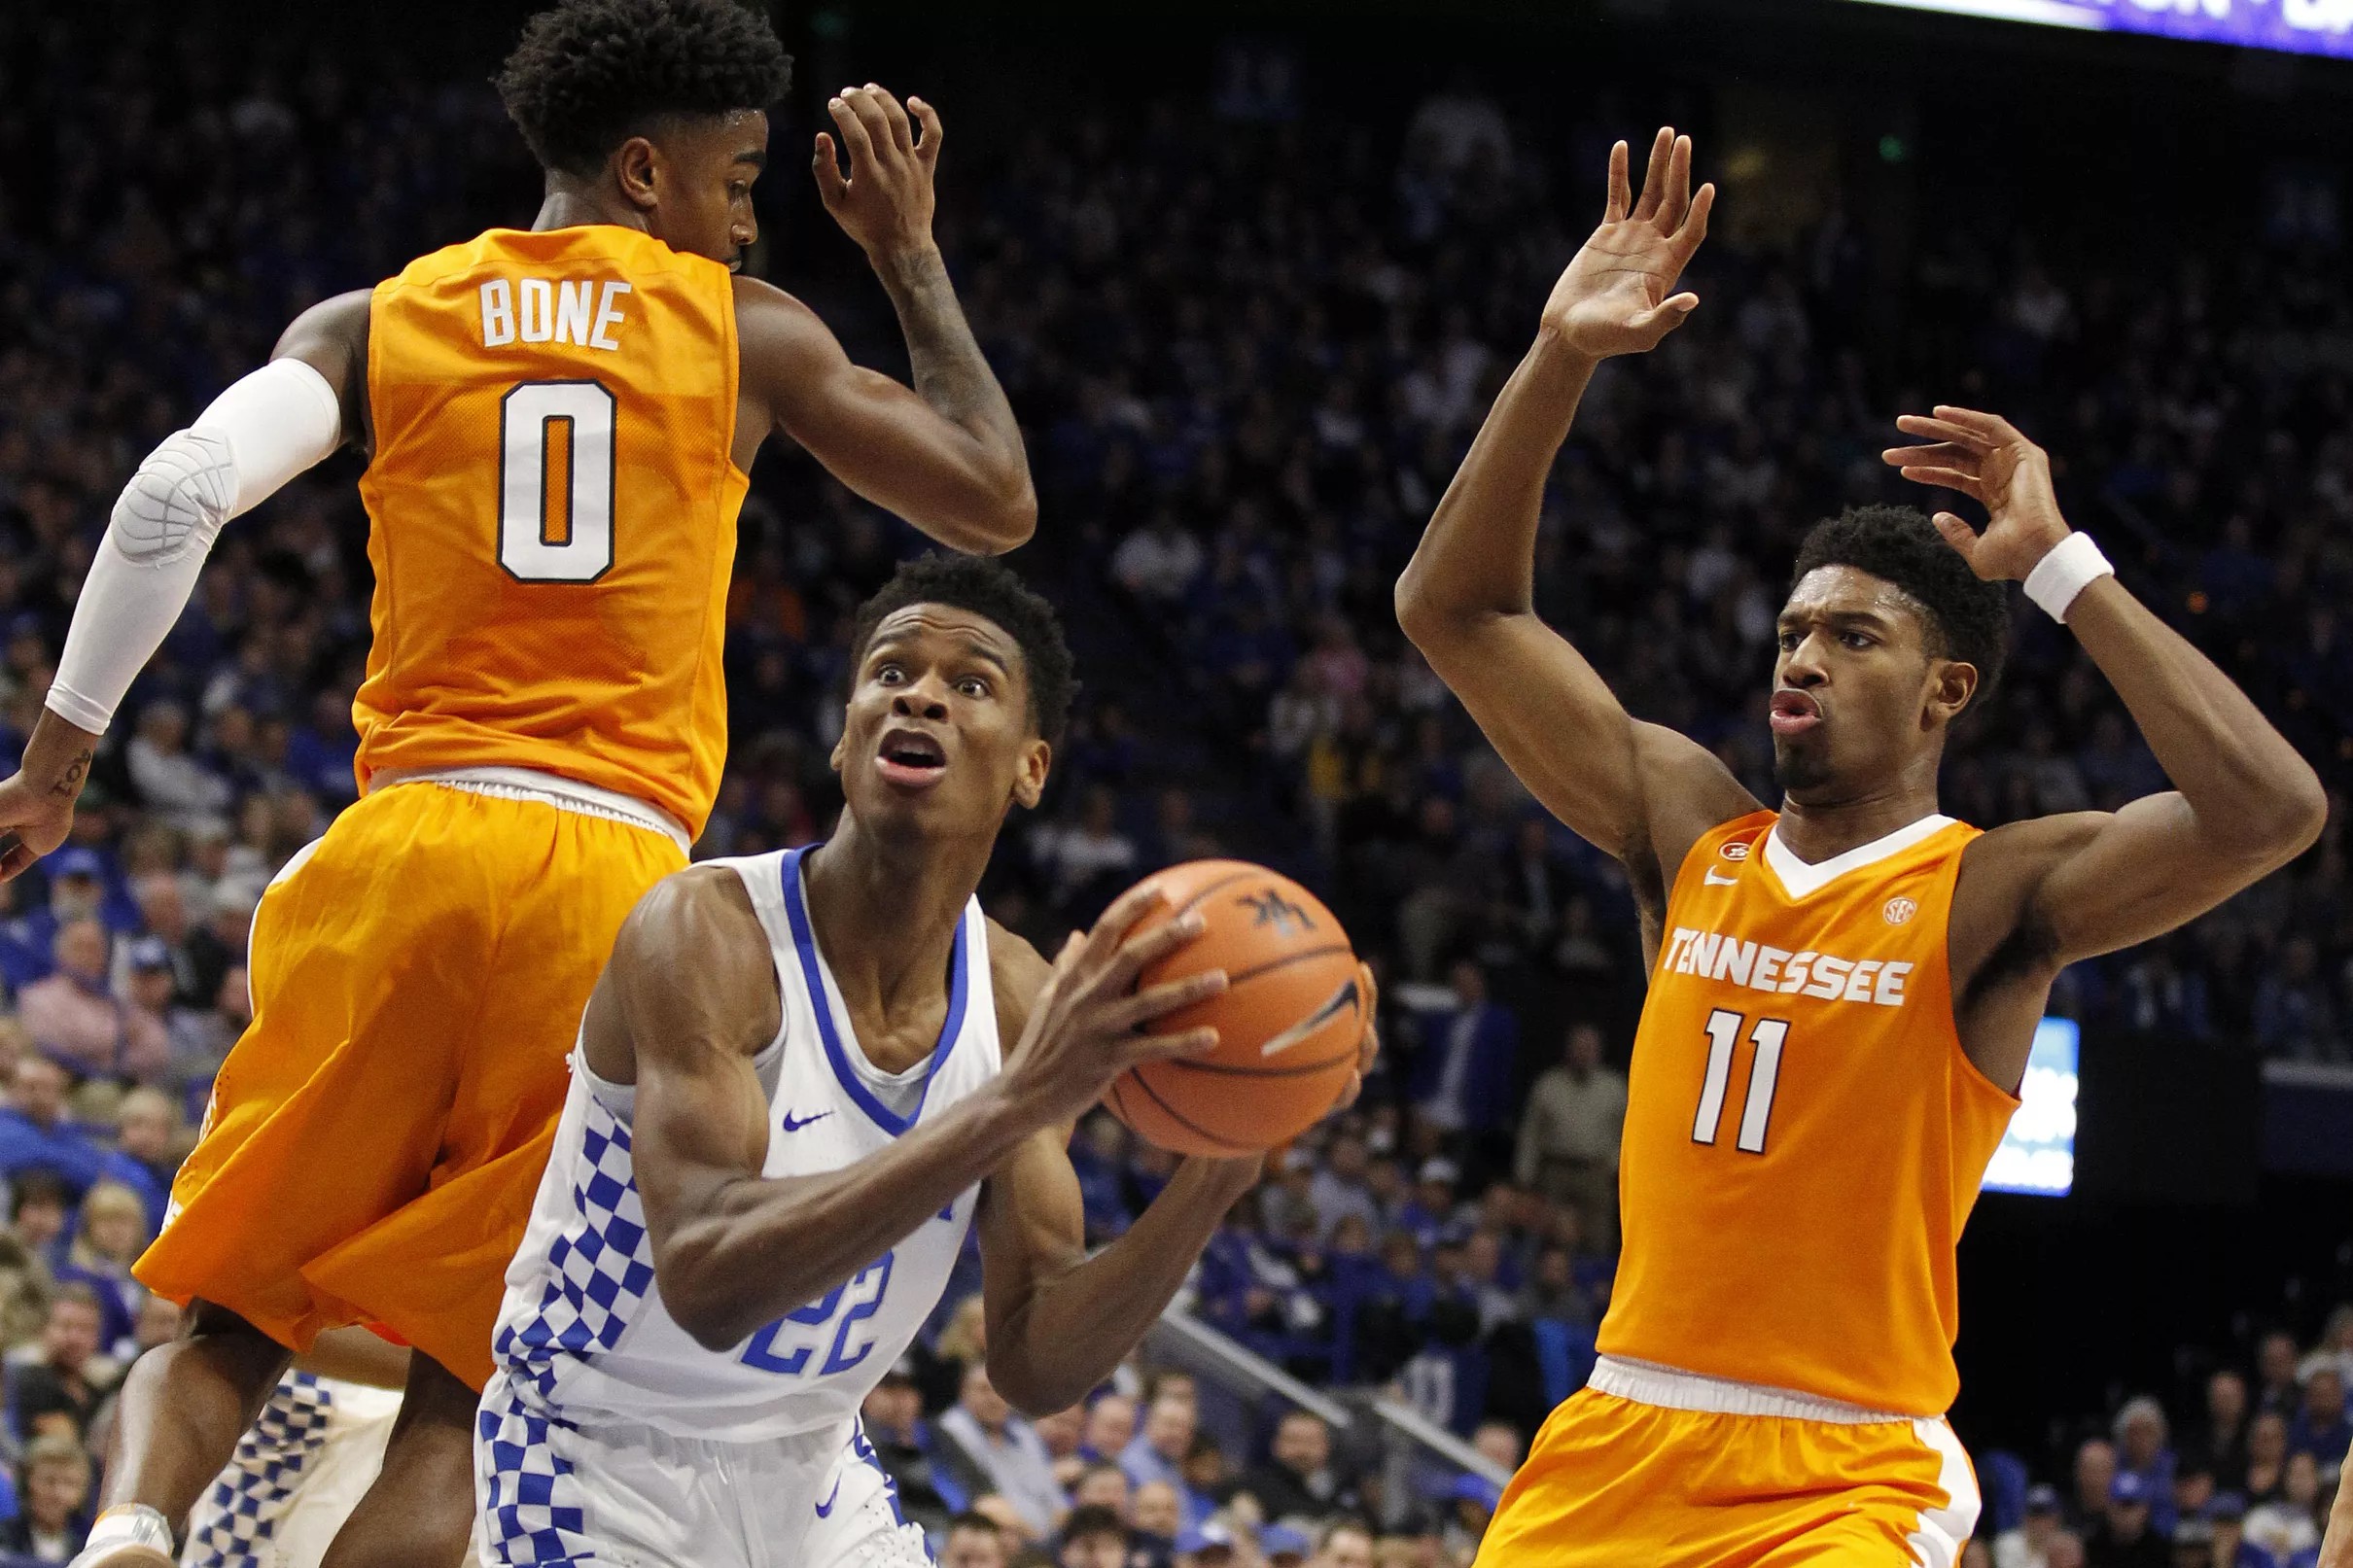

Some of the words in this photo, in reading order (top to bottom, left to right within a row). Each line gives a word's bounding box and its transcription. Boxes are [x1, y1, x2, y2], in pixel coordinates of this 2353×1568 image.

[479, 278, 632, 351] BONE
[497, 378, 617, 585] 0
[1884, 898, 1915, 923] SEC
[1664, 926, 1914, 1007] TENNESSEE
[1691, 1007, 1791, 1154] 11
[740, 1248, 895, 1376] 22
